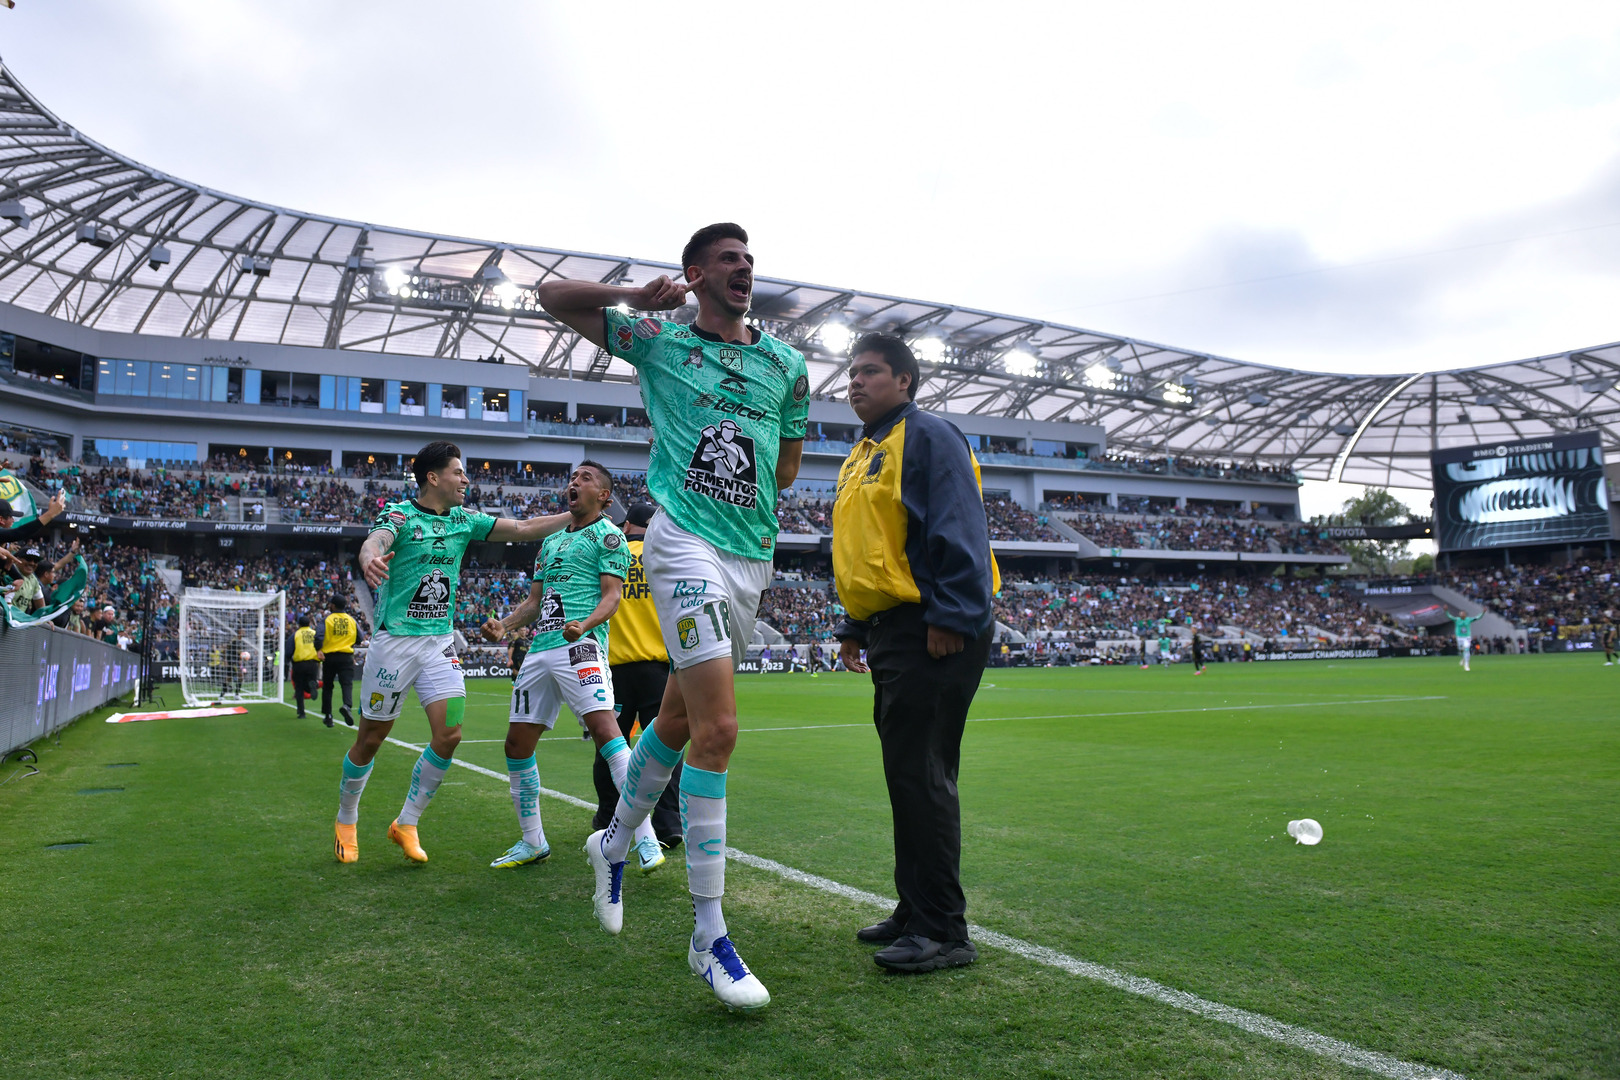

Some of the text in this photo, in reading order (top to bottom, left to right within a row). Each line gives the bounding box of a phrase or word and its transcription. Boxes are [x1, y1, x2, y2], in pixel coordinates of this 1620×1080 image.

[713, 397, 768, 421] telcel
[1473, 442, 1553, 457] BMO STADIUM
[686, 469, 758, 497] CEMENTOS
[683, 479, 756, 510] FORTALEZA
[132, 520, 187, 529] NITTOTIRE.COM
[215, 523, 267, 532] NITTOTIRE.COM
[292, 525, 342, 534] NITTOTIRE.COM
[1329, 528, 1367, 536] TOYOTA
[429, 554, 457, 565] telcel
[546, 573, 574, 583] telcel
[622, 584, 651, 599] TAFF
[672, 579, 708, 599] Red
[1364, 586, 1412, 596] FINAL 2023
[409, 603, 449, 611] CEMENTOS
[681, 595, 704, 608] Cola
[1316, 650, 1354, 659] CHAMPIONS
[1355, 649, 1379, 658] LEAGUE
[376, 667, 399, 681] Red
[580, 674, 602, 686] León
[378, 680, 395, 689] Cola
[390, 691, 402, 714] 7
[515, 689, 530, 714] 11
